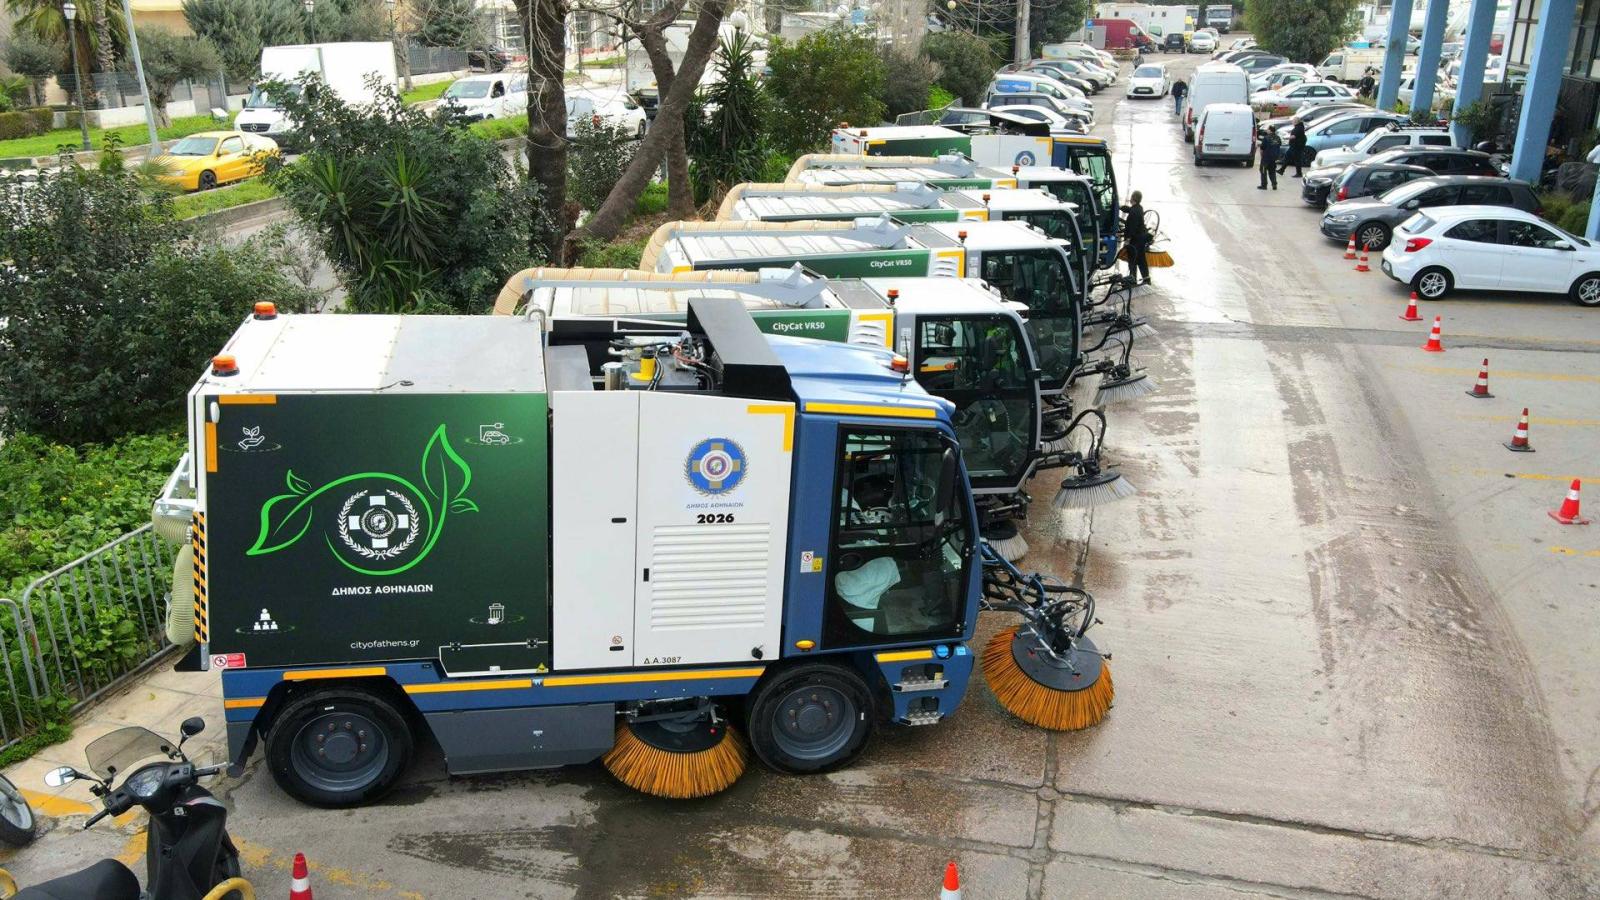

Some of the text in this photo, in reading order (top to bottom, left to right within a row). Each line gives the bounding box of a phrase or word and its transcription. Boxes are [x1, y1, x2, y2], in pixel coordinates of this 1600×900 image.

[870, 260, 894, 269] CityCat
[772, 321, 825, 332] CityCat VR50
[697, 513, 735, 524] 2026
[332, 584, 434, 596] ΔΗΜΟΣ ΑΘΗΝΑΙΩΝ
[350, 639, 420, 650] cityofathens.gr
